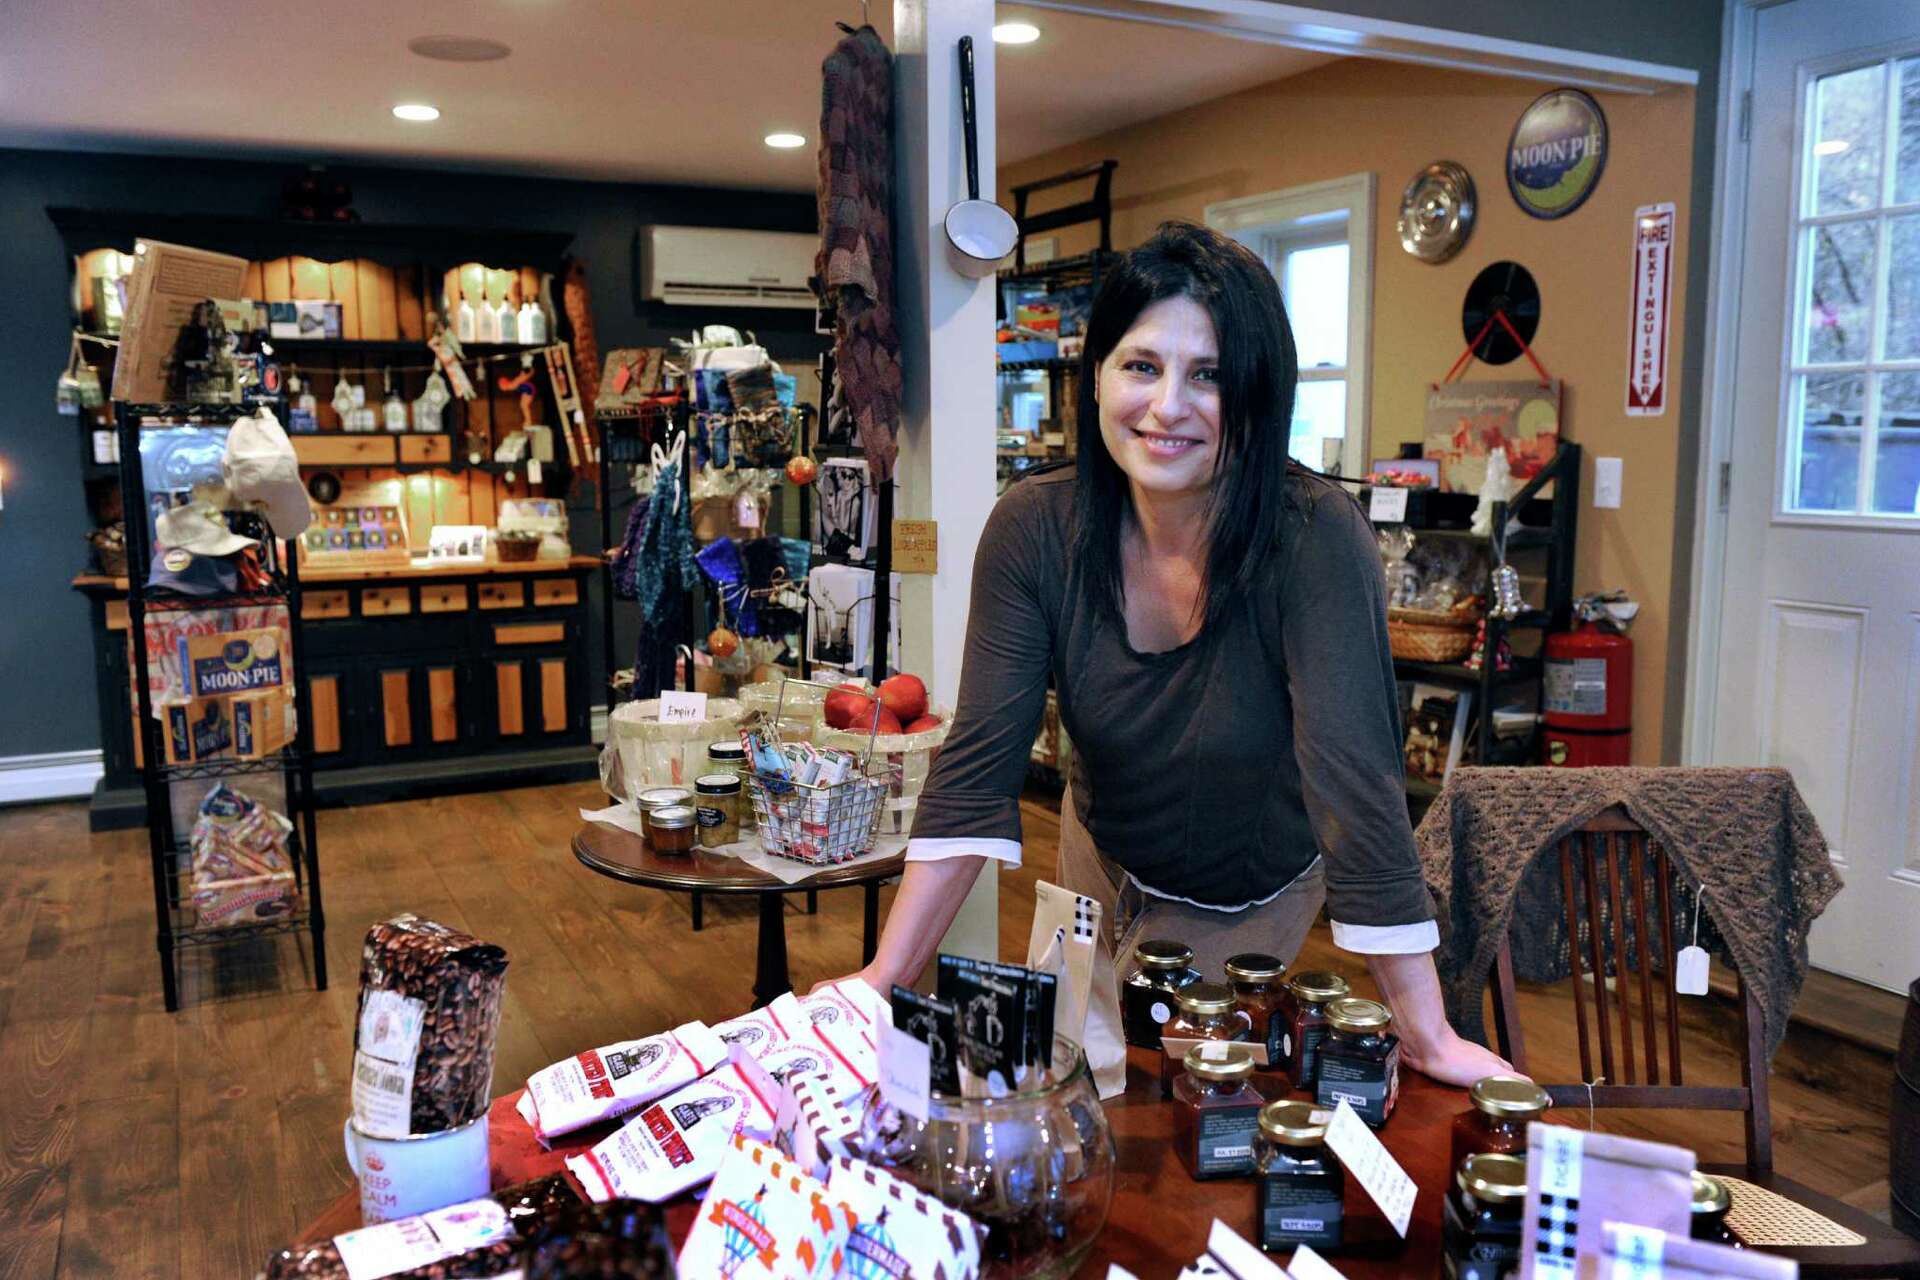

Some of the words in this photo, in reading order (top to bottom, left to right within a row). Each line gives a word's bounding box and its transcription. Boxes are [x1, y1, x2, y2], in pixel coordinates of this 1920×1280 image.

[1512, 139, 1567, 169] MOON
[1570, 134, 1602, 160] PIE
[1640, 224, 1669, 243] FIRE
[1641, 247, 1658, 396] EXTINGUISHER
[200, 671, 249, 690] MOON
[252, 665, 280, 683] PIE
[666, 704, 697, 719] Empire
[363, 1174, 391, 1190] KEEP
